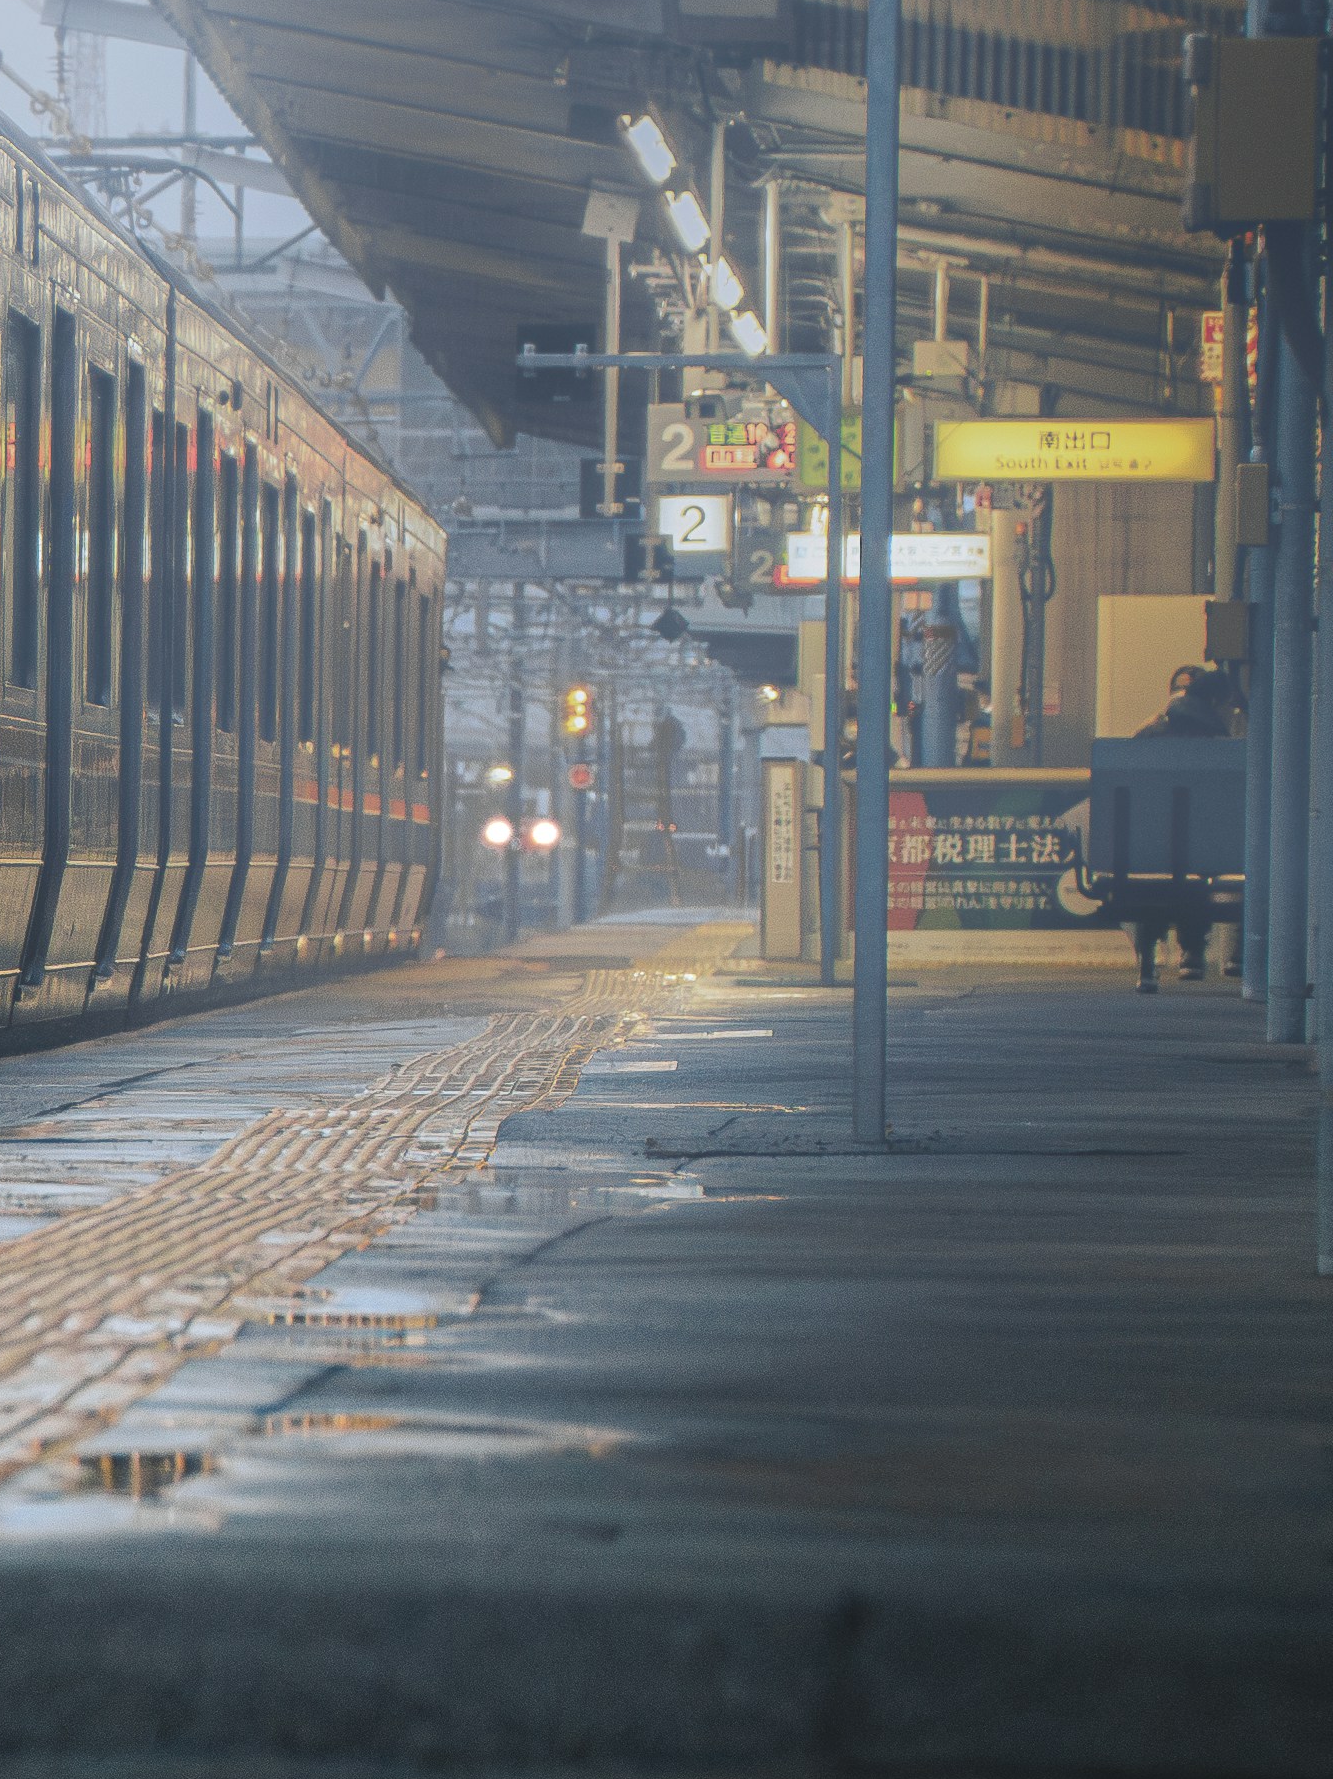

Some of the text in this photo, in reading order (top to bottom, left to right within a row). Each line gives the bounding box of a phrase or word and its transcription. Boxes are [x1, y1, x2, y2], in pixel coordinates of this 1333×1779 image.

[661, 423, 695, 471] 2
[1039, 431, 1111, 450] 南出口
[995, 454, 1049, 470] South
[1055, 456, 1088, 470] Exit
[680, 504, 706, 543] 2
[749, 551, 774, 584] 2
